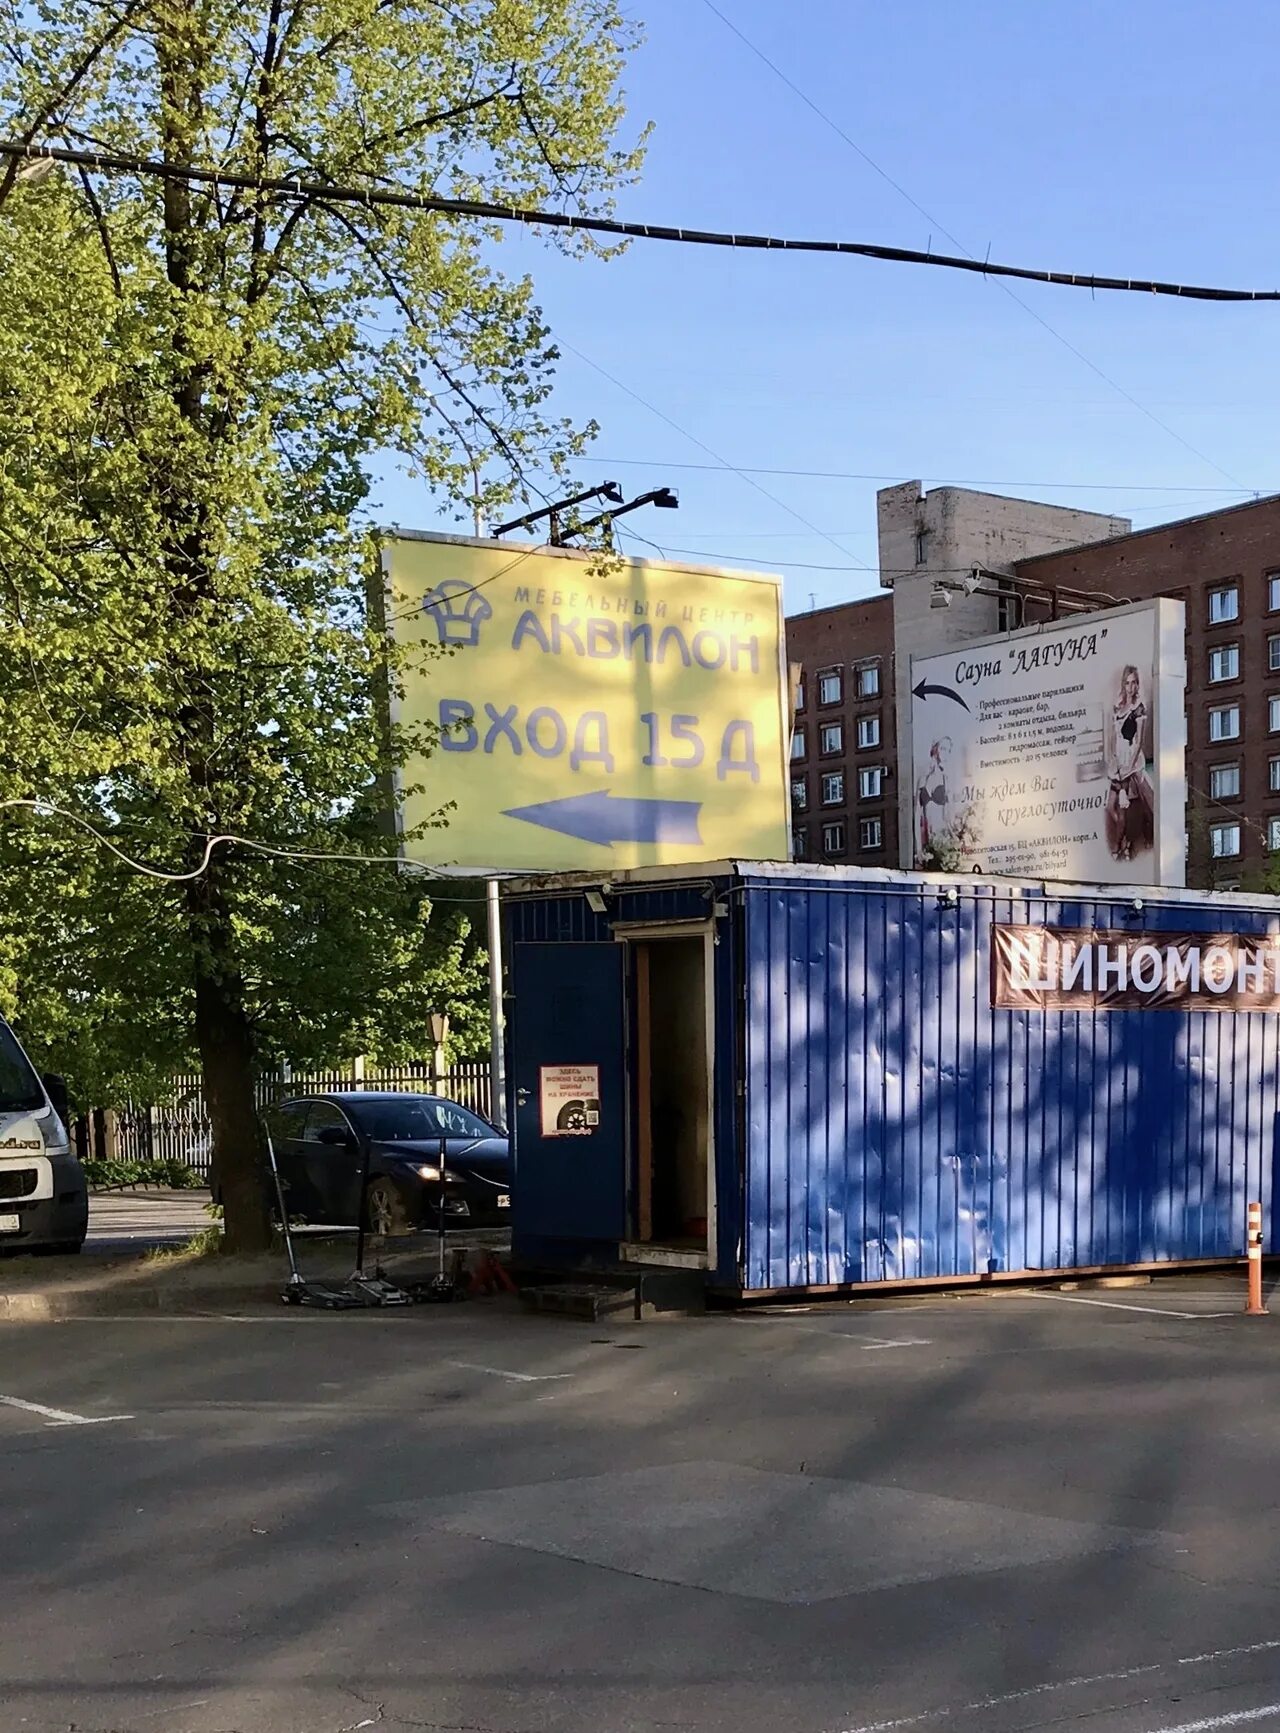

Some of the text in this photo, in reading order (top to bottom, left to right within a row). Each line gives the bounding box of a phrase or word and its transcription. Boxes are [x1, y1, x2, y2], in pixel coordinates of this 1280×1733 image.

[514, 586, 755, 625] МЕБЕЛЬНЫЙ ЦЕНТР
[512, 610, 760, 674] АКВИЛОН
[955, 660, 1002, 686] Сауна
[980, 693, 1041, 711] Профессиональные
[1003, 719, 1031, 729] комнаты
[1058, 709, 1087, 720] бильярд
[439, 699, 761, 783] ВХОД 15 Д
[980, 756, 1021, 769] Вместимость
[1041, 749, 1069, 759] человек
[961, 775, 1057, 803] Мы ждем Вас
[997, 790, 1109, 827] круглосуточно!
